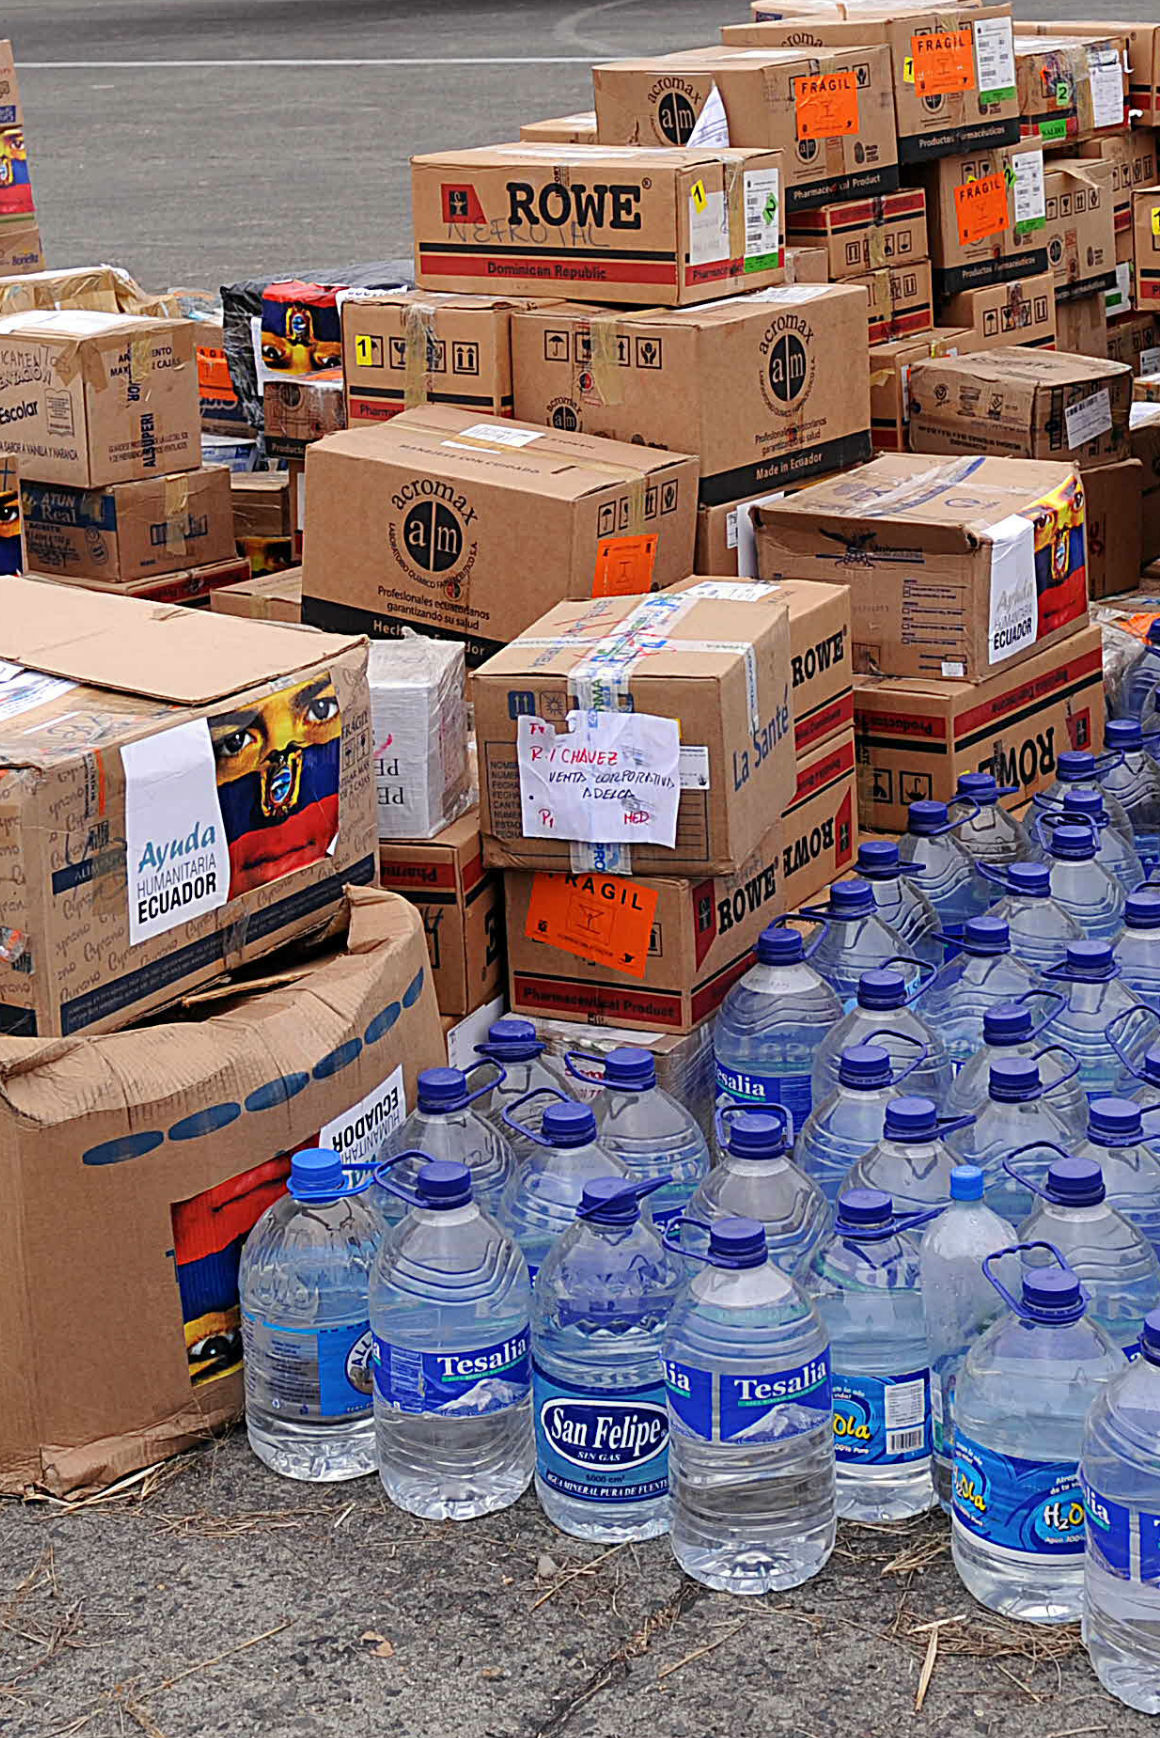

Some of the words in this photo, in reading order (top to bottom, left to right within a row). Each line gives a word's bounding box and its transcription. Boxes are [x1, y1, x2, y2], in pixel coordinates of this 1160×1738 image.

[917, 36, 965, 53] FRAGIL
[905, 60, 913, 76] 1
[800, 78, 851, 95] FRAGIL
[1057, 86, 1068, 100] 2
[693, 185, 702, 203] 1
[852, 174, 881, 188] Product
[959, 177, 1002, 202] FRAGIL
[507, 181, 641, 230] ROWE
[765, 197, 777, 220] 2
[487, 261, 552, 278] Dominican
[554, 264, 607, 281] Republic
[357, 338, 367, 357] 1
[759, 314, 815, 356] acromax
[0, 400, 38, 425] Escolar
[756, 465, 779, 481] Made
[781, 462, 789, 474] in
[790, 452, 823, 471] Ecuador
[40, 505, 77, 523] Real
[391, 478, 479, 527] acromax
[377, 584, 433, 609] Profesionales
[386, 602, 443, 623] garantizando
[443, 615, 455, 625] su
[455, 616, 480, 631] salud
[993, 617, 1032, 651] ECUADOR
[790, 629, 845, 689] ROWE
[732, 746, 750, 793] La
[752, 682, 790, 770] Santé
[561, 747, 619, 766] CHAVEZ
[549, 770, 587, 783] VENTA
[595, 770, 676, 789] CORPORATIVA
[582, 786, 635, 801] ADELCA
[137, 821, 216, 874] Ayuda
[782, 816, 835, 877] ROWE
[136, 852, 217, 900] HUMANITARIA
[137, 871, 217, 925] ECUADOR
[549, 873, 644, 911] RAGIL
[716, 864, 778, 935] ROWE
[715, 1065, 766, 1099] esalia
[332, 1086, 400, 1154] ECUADOR
[436, 1336, 527, 1377] Tesalia
[733, 1360, 828, 1401] Tesalia
[551, 1407, 588, 1447] San
[591, 1414, 661, 1457] Felipe
[577, 1451, 596, 1460] SIN
[598, 1453, 621, 1462] GAS
[624, 1487, 637, 1496] DE
